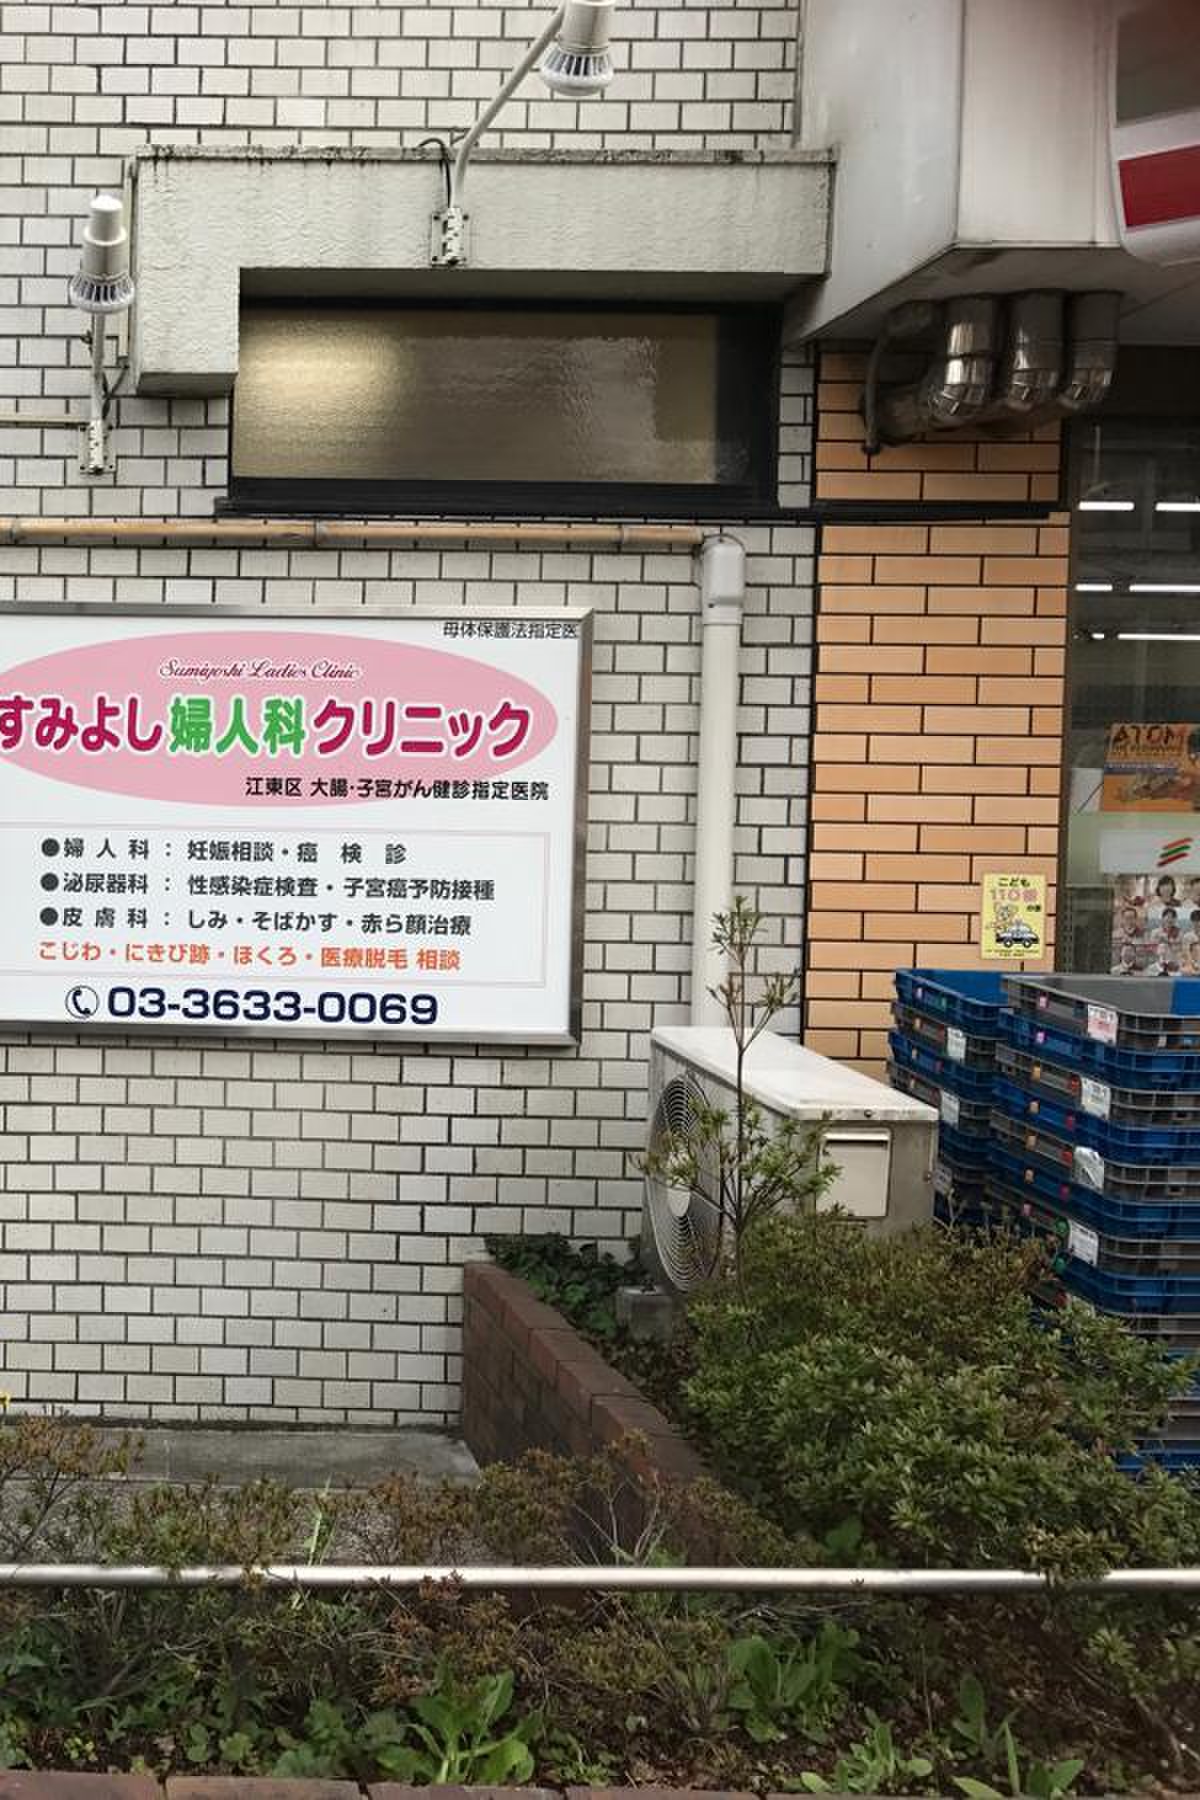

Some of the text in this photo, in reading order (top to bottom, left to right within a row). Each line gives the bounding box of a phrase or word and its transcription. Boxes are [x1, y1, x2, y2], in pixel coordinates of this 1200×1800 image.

[443, 622, 578, 639] 母体保護法指定医
[160, 659, 361, 680] Sumiyoshi Ladies Clinic
[245, 777, 302, 797] 江東区
[416, 949, 461, 970] 相談
[107, 986, 439, 1025] 03-3633-0069
